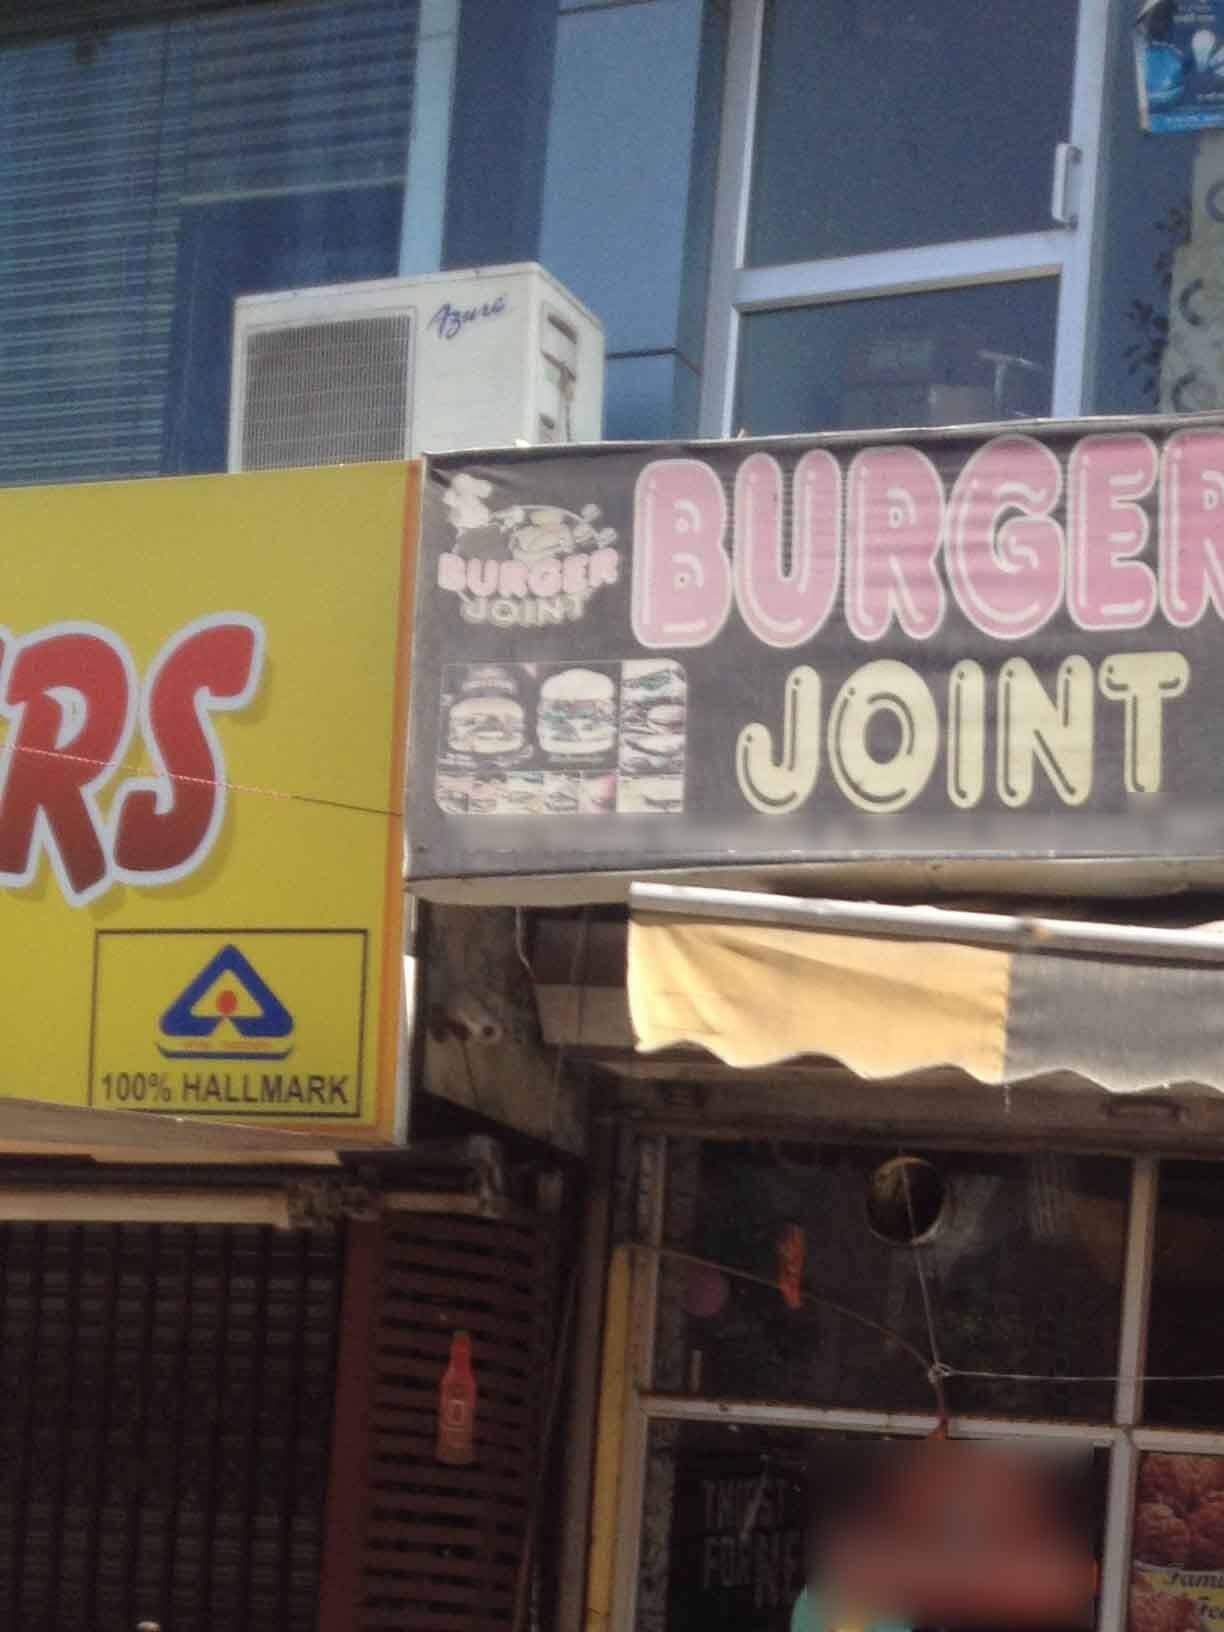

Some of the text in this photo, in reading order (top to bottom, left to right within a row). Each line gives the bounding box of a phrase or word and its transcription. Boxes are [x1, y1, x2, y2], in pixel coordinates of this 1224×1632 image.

[438, 548, 619, 597] BURGER
[736, 650, 1190, 815] JOINT
[101, 1072, 349, 1104] 100% HALLMARK
